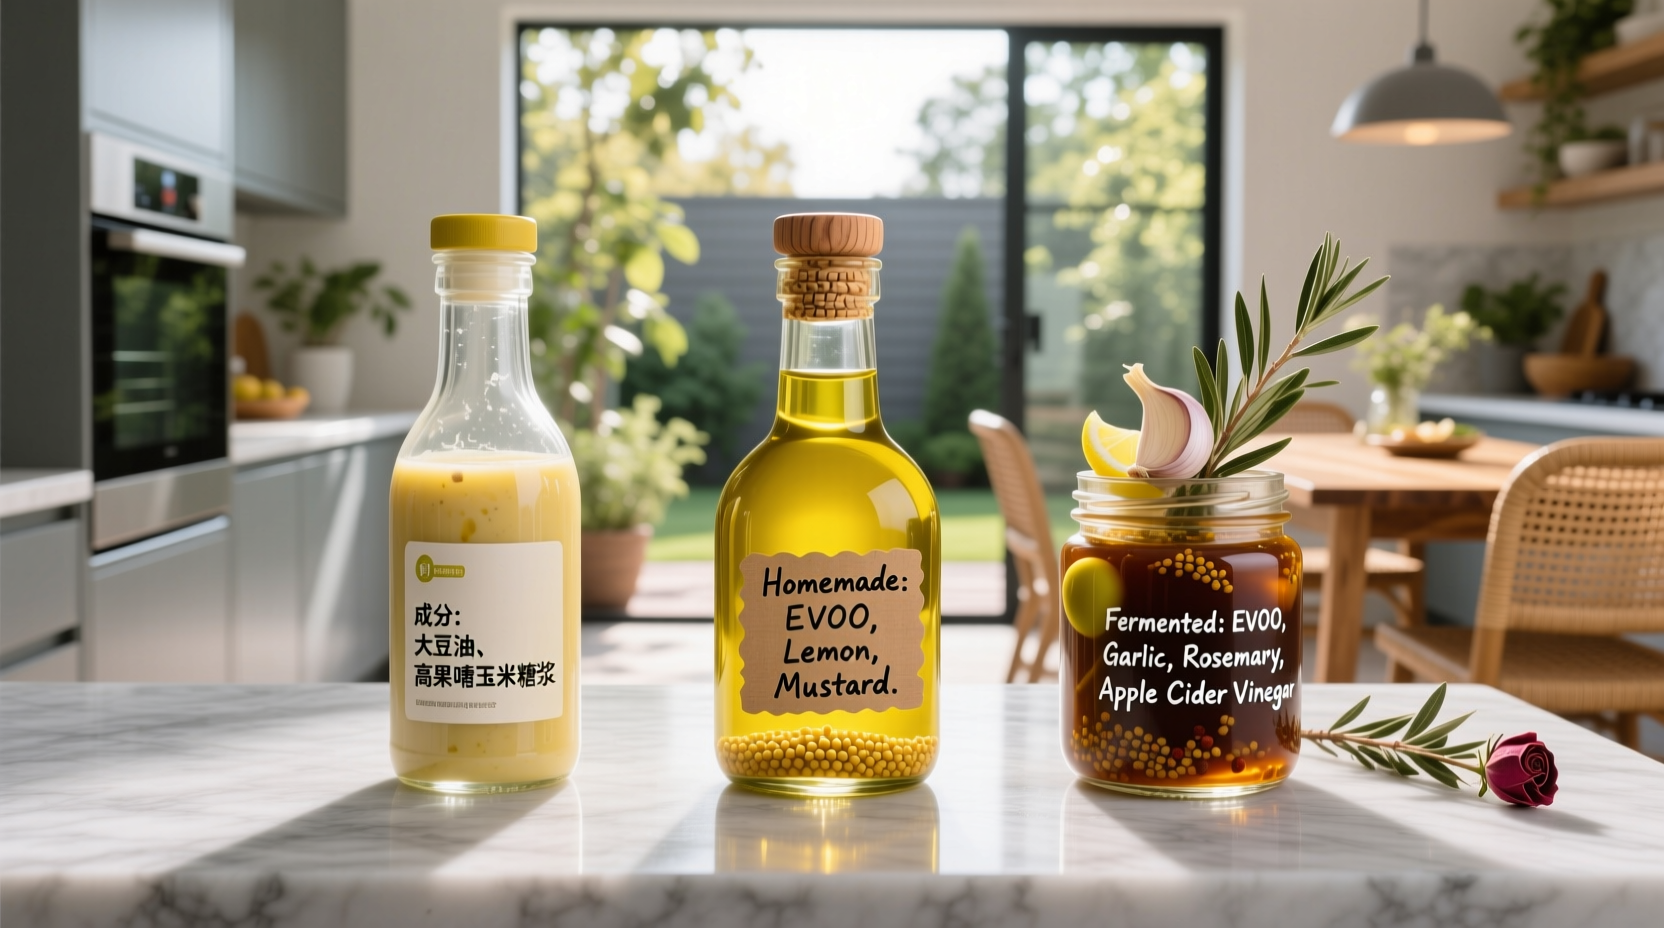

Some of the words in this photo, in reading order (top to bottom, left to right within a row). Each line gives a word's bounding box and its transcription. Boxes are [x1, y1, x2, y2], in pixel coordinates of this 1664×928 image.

[762, 563, 908, 597] Homemade:
[414, 602, 461, 627] 成分：
[786, 602, 877, 634] EVOO,
[1105, 607, 1225, 634] Fermented:
[1232, 606, 1286, 633] EVOO,
[414, 633, 484, 658] 大豆油、
[783, 638, 879, 665] Lemon,
[1103, 641, 1173, 673] Garlic,
[1183, 643, 1284, 673] Rosemary,
[773, 664, 898, 699] Mustard.
[1098, 676, 1158, 712] Apple
[1166, 679, 1228, 705] Cider
[1233, 679, 1295, 711] Vinegar
